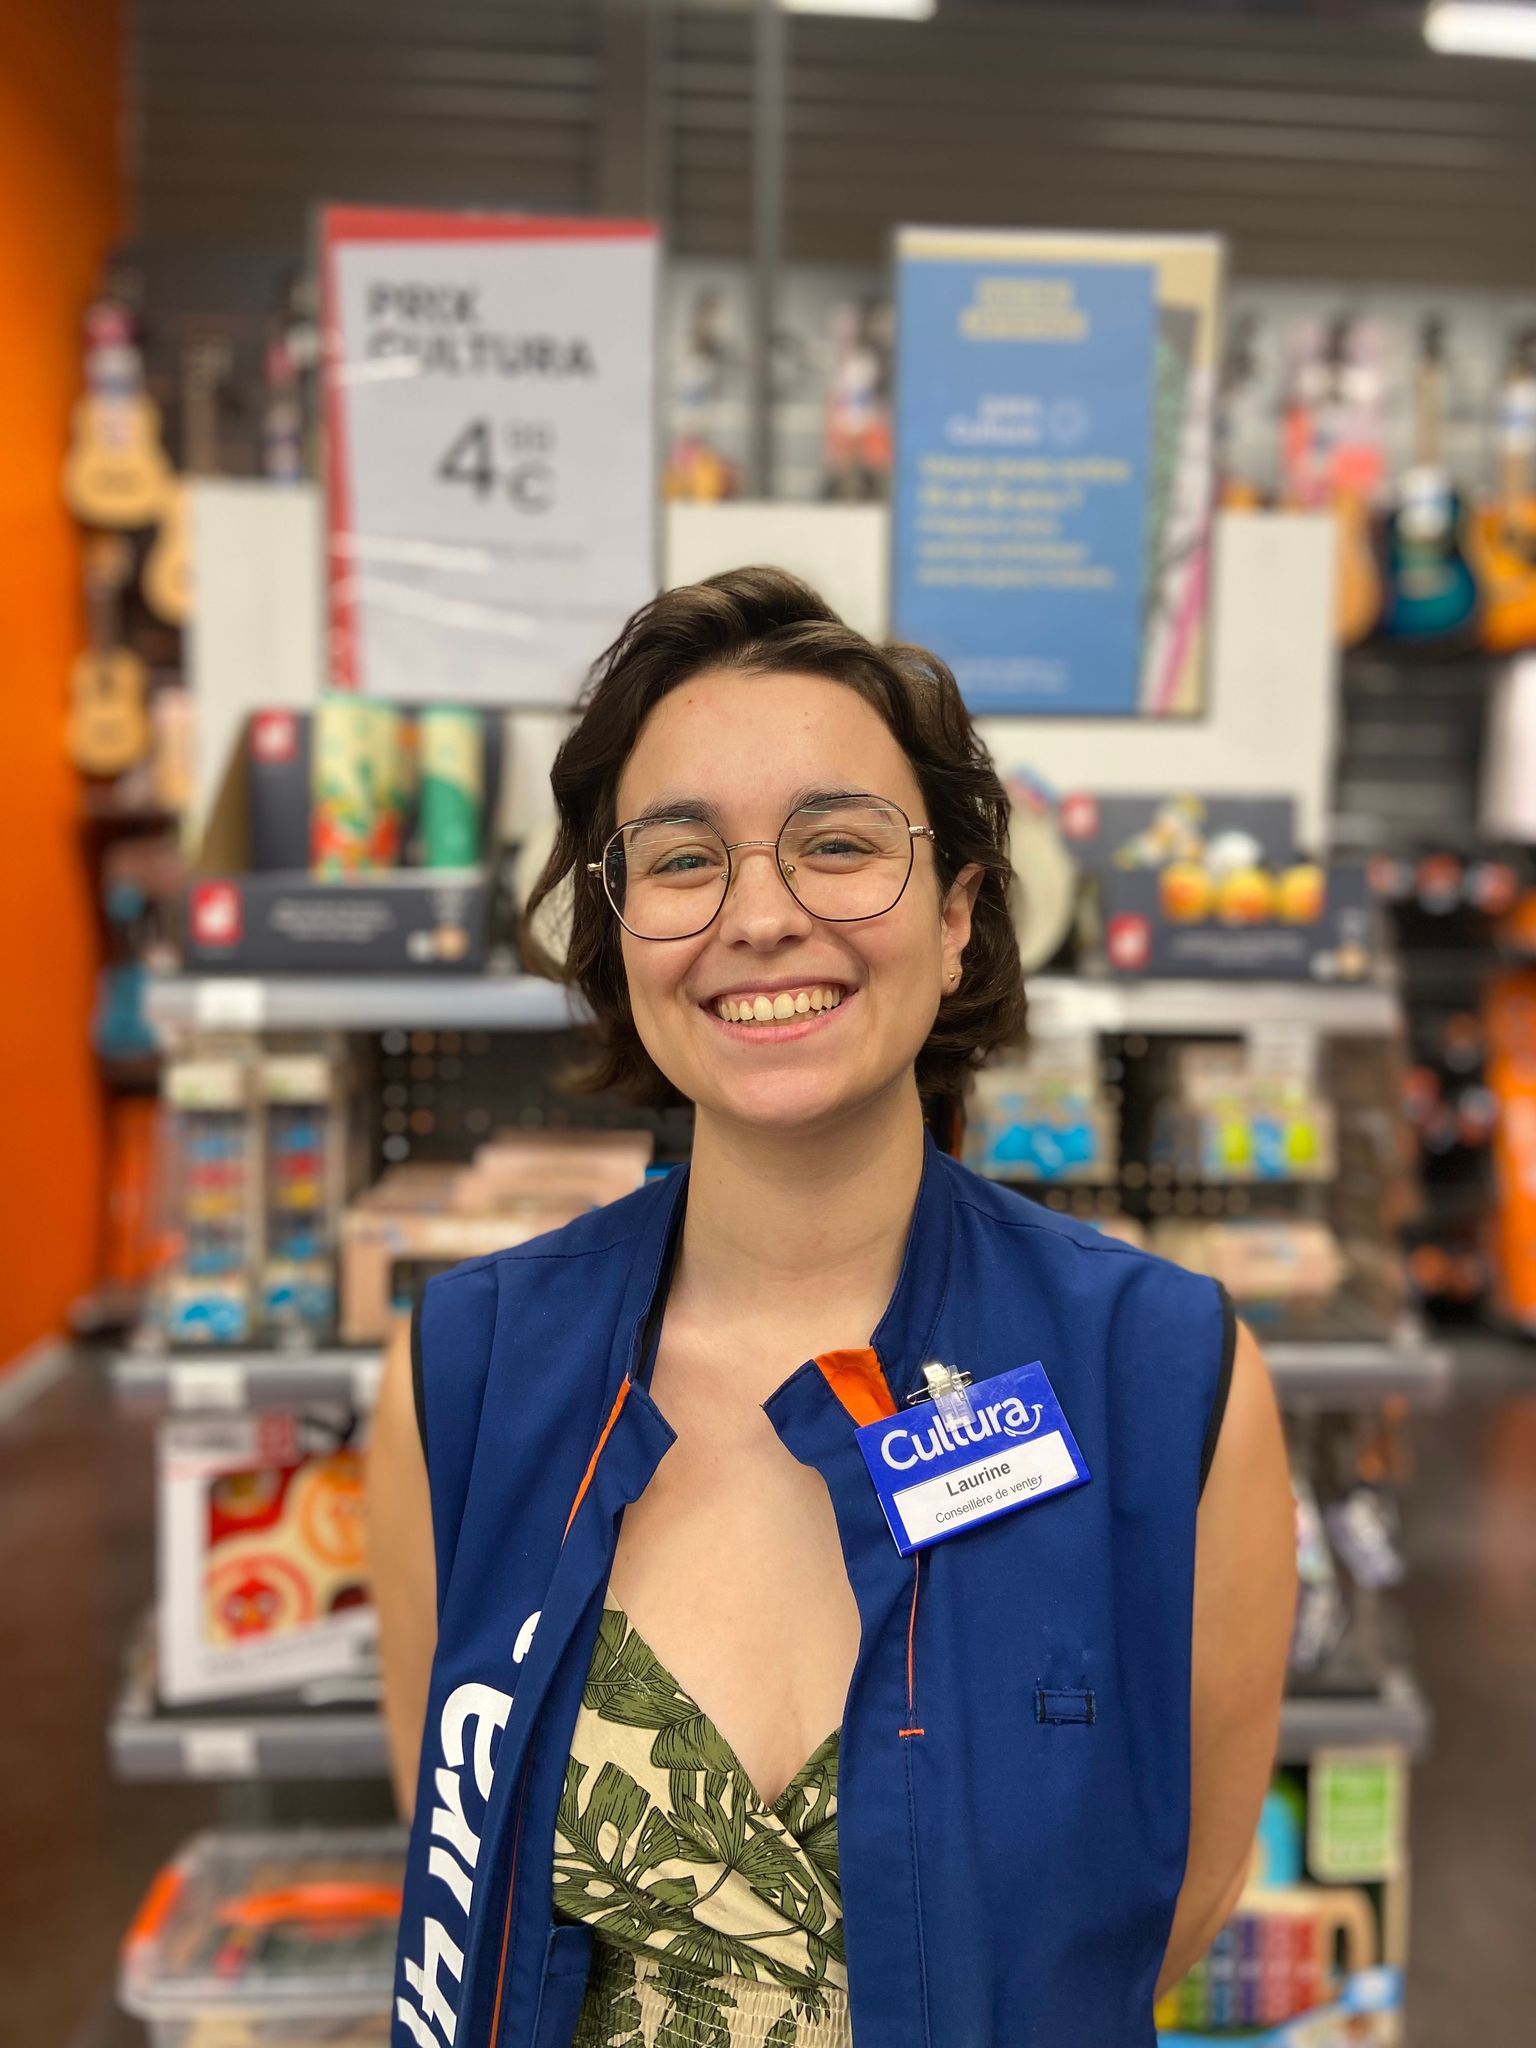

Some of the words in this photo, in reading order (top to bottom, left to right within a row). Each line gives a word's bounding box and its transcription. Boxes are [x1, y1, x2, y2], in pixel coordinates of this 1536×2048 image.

[367, 280, 478, 324] PRIX
[367, 331, 597, 380] CULTURA
[437, 415, 496, 500] 4
[880, 1397, 1030, 1471] Cultura
[935, 1493, 994, 1524] Conseillère
[995, 1486, 1009, 1501] de
[1010, 1475, 1038, 1494] vente
[945, 1462, 1012, 1497] Laurine
